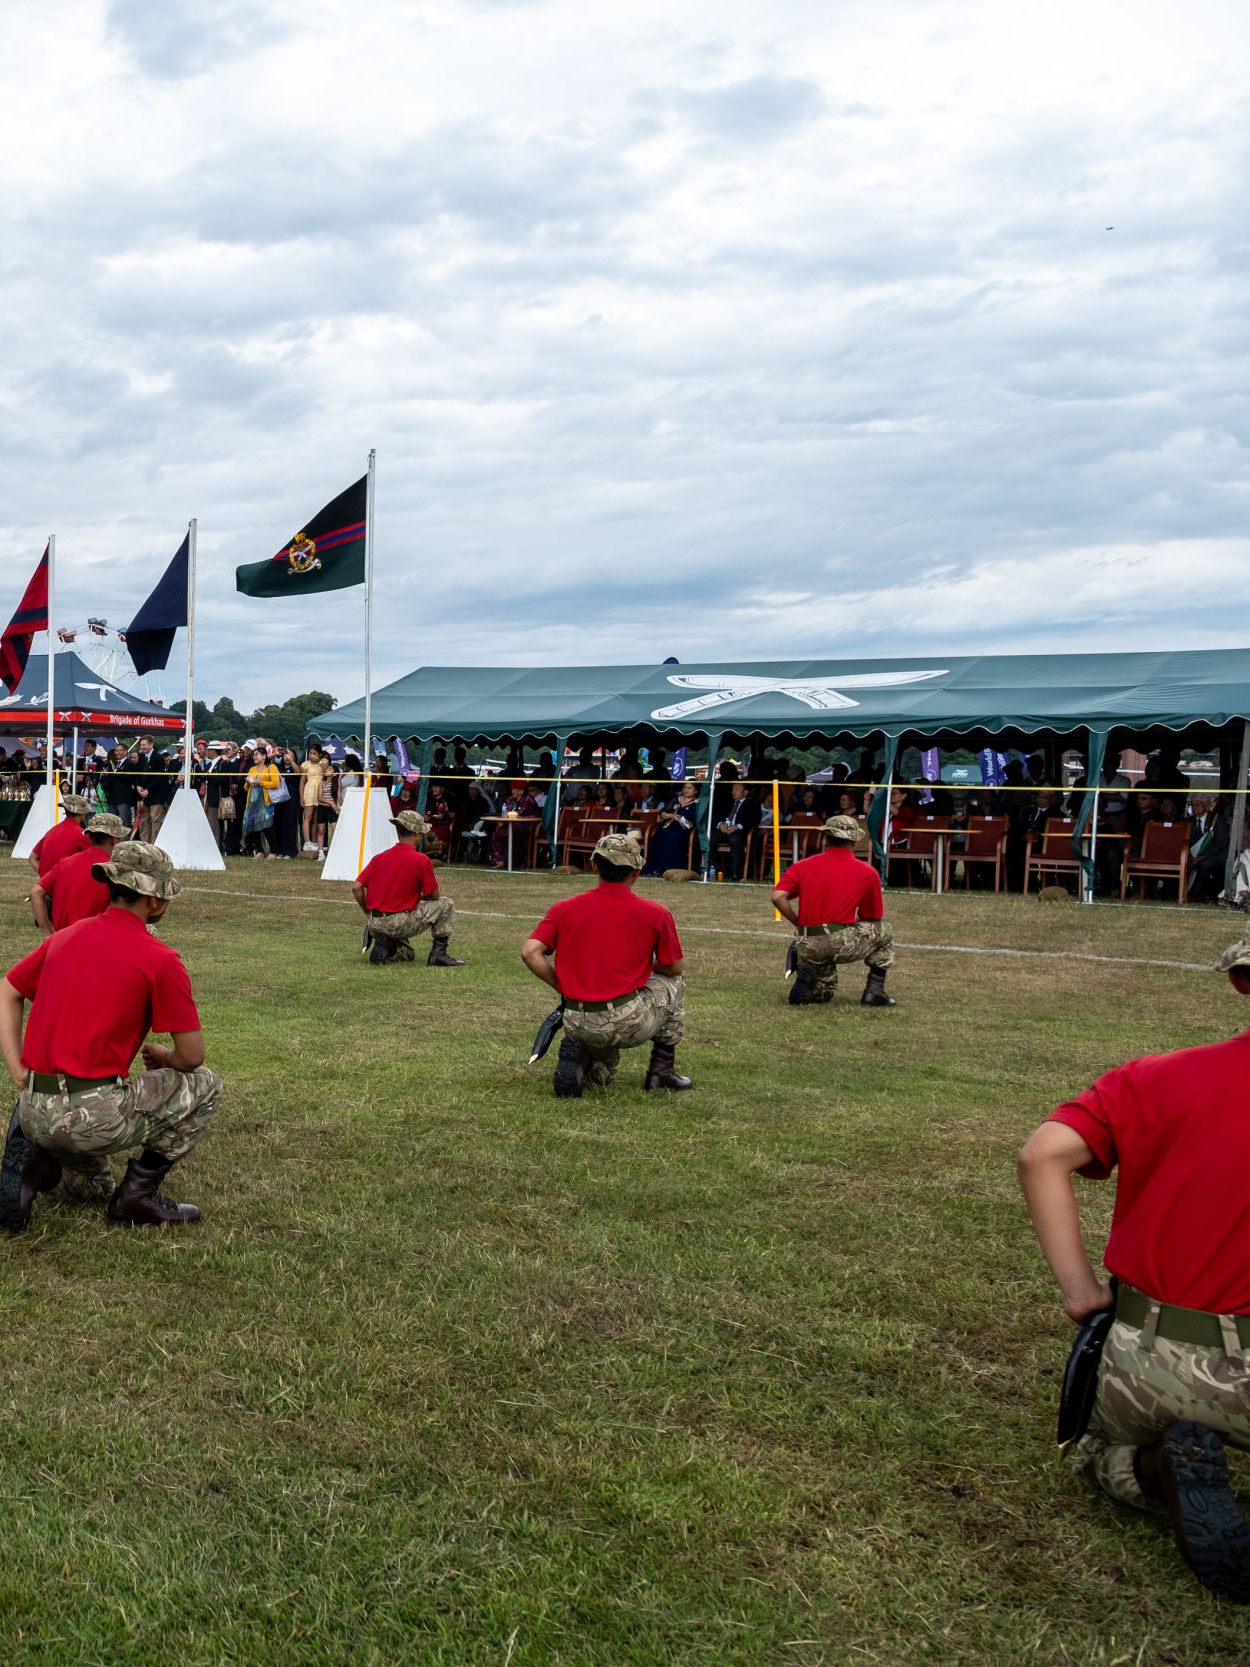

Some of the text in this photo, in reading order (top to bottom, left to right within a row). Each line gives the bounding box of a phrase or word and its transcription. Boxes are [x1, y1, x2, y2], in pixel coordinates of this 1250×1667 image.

[110, 714, 165, 726] Brigade of Gurkhas
